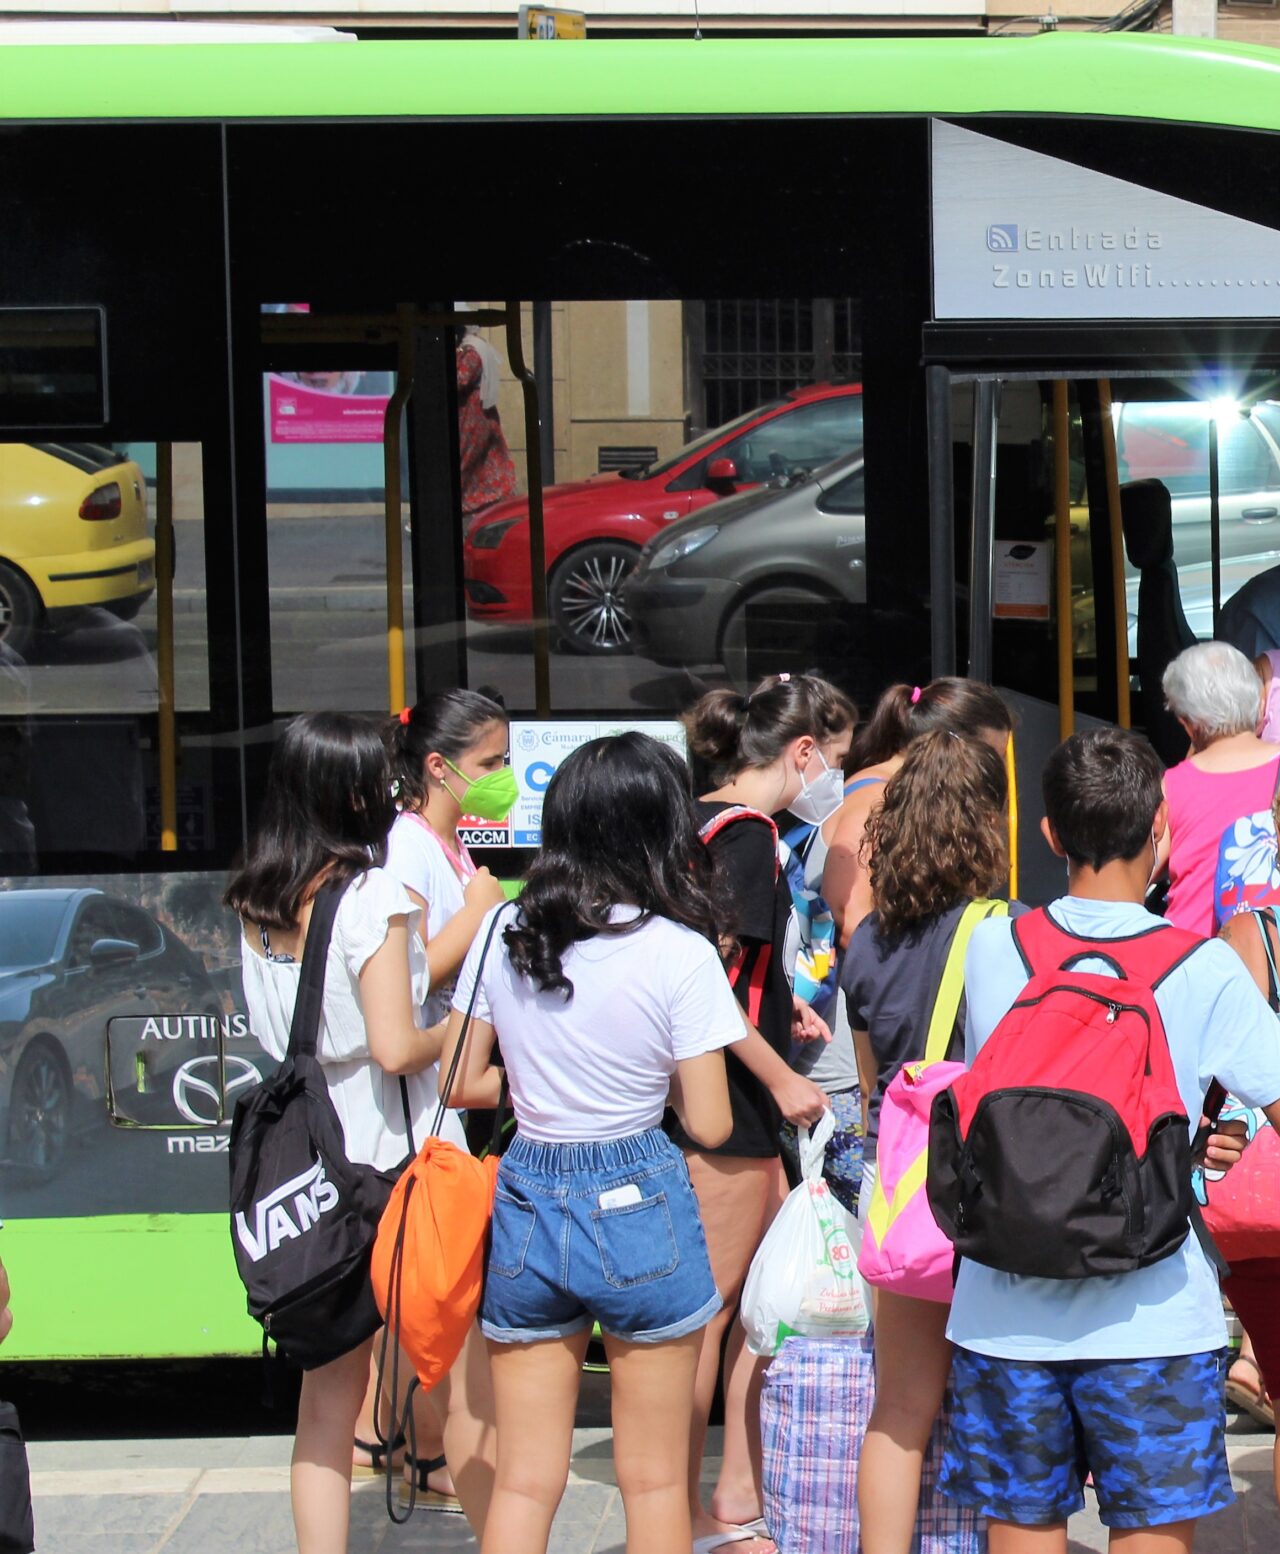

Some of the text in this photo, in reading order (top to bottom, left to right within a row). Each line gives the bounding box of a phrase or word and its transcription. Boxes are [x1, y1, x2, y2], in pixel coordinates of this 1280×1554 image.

[1024, 226, 1164, 251] Entrada
[461, 830, 506, 844] ACCM
[235, 1158, 339, 1263] VANS
